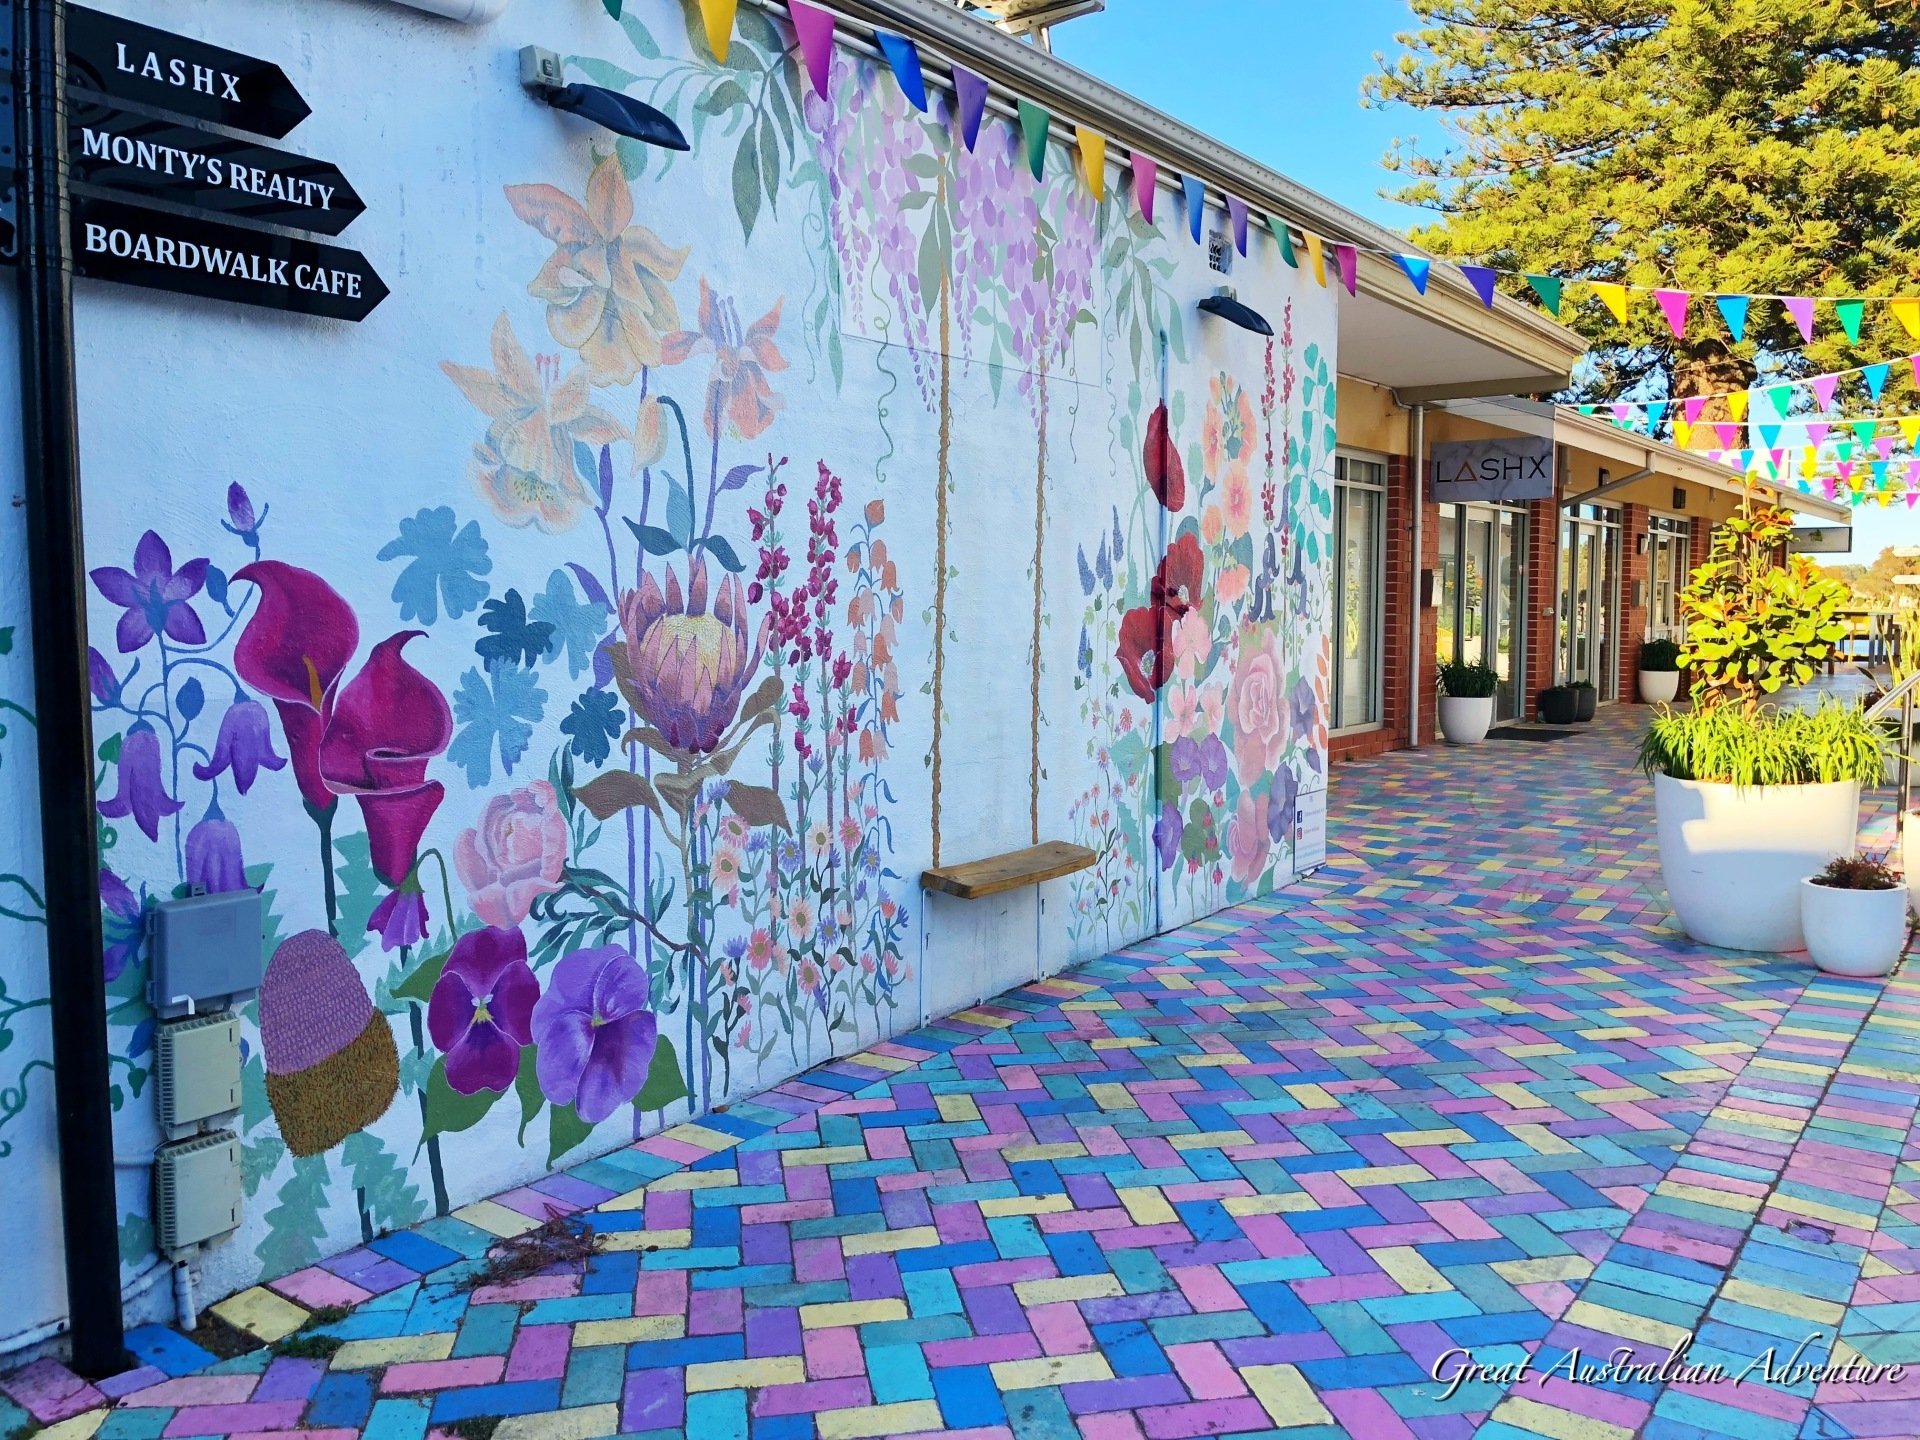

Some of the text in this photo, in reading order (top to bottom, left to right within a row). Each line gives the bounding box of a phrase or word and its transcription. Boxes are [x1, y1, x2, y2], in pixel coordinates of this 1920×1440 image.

[116, 43, 241, 103] LASHX
[229, 163, 335, 211] REALTY
[85, 223, 362, 299] BOARDWALK CAFE
[1436, 455, 1547, 483] LASHX
